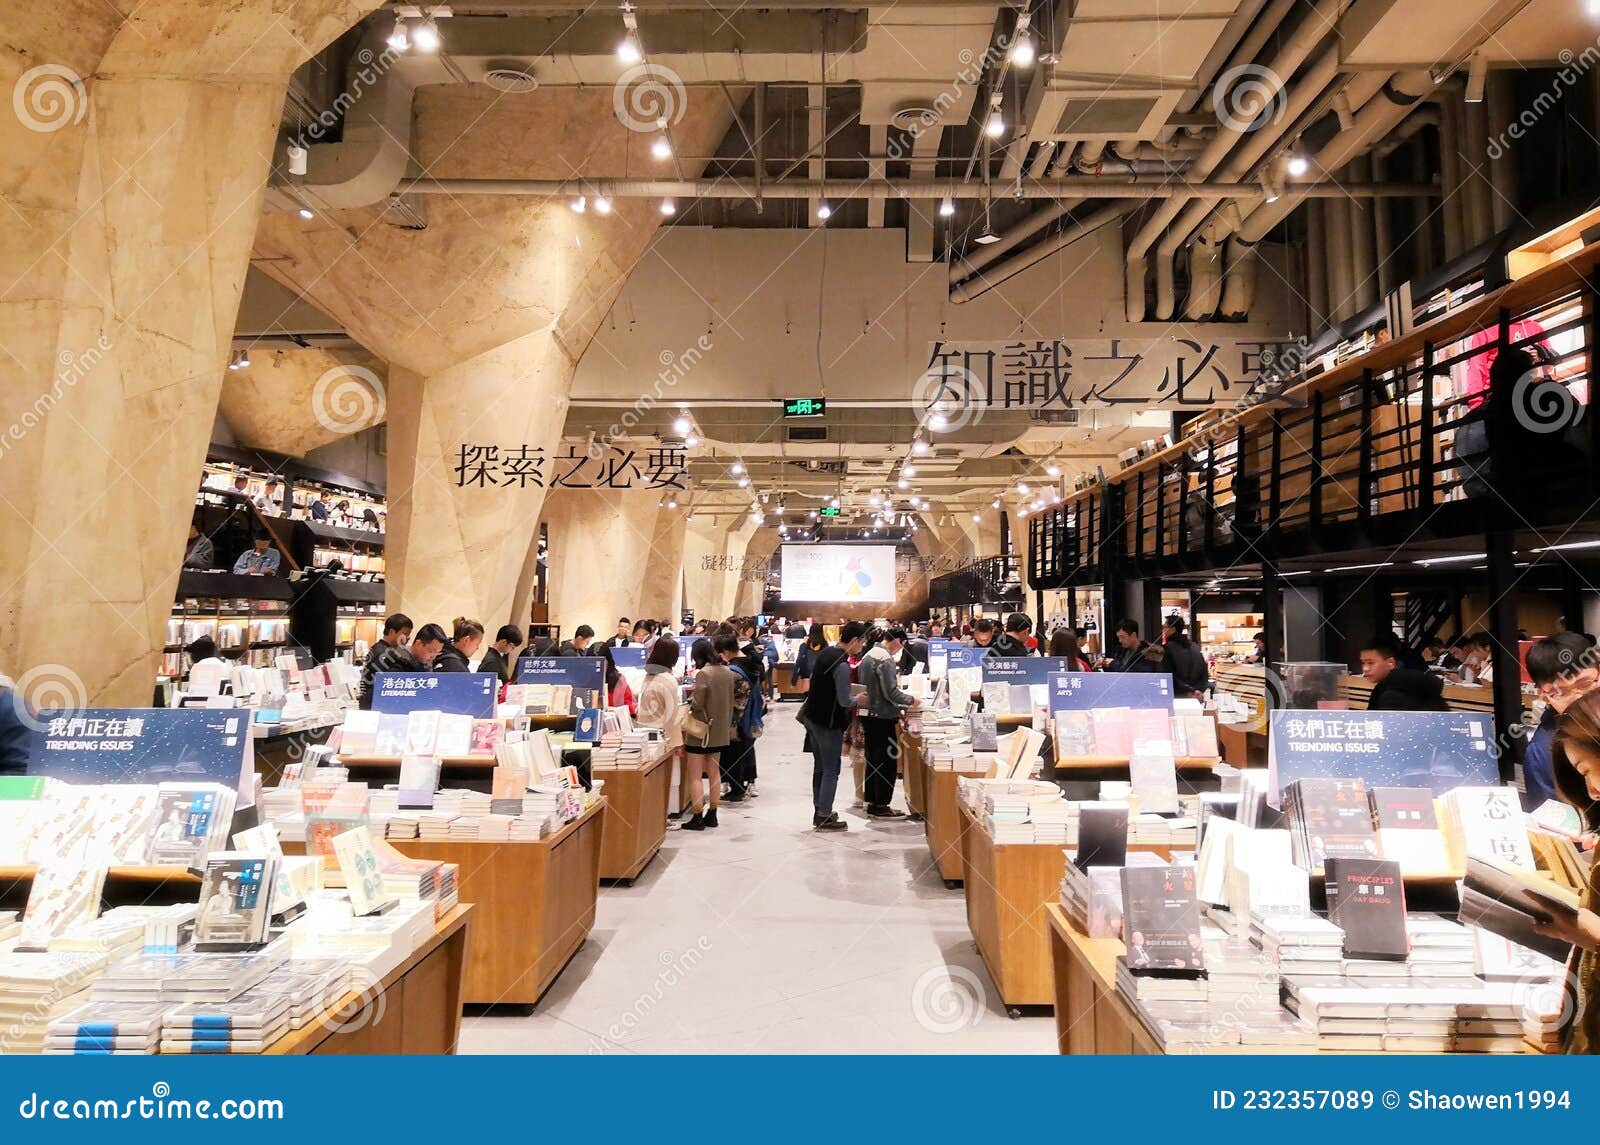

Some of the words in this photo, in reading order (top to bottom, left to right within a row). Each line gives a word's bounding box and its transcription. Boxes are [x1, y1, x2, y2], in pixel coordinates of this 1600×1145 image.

[454, 444, 689, 490] 探索之必要
[700, 554, 780, 571] 凝視之必
[382, 677, 438, 690] 港台版文學
[1056, 677, 1082, 689] 藝術
[47, 717, 145, 737] 我們正在讀
[1286, 719, 1385, 740] 我們正在讀
[45, 740, 98, 751] TRENDING
[99, 740, 134, 751] ISSUES
[1288, 742, 1343, 752] TRENDING
[1345, 742, 1380, 753] ISSUES
